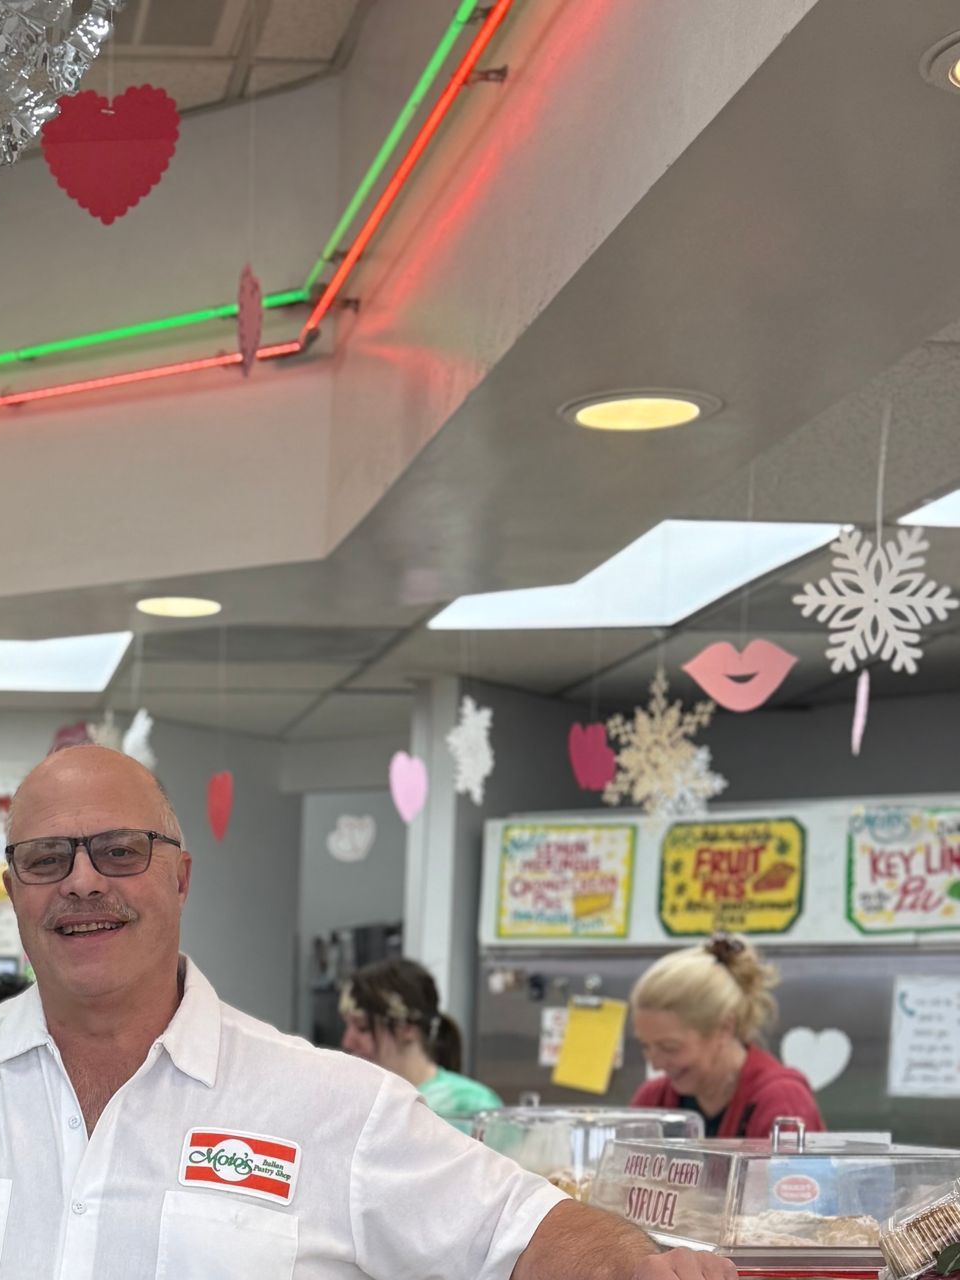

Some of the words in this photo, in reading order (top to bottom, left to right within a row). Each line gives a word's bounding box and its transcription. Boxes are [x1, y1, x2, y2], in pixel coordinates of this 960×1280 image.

[693, 845, 766, 880] FRUIT
[869, 846, 915, 884] KEY
[188, 1147, 254, 1176] Moio's
[253, 1164, 275, 1177] Pastry
[275, 1169, 292, 1181] Shop
[262, 1159, 284, 1171] Italian
[624, 1154, 649, 1178] APPLE
[668, 1160, 702, 1186] CHERRY
[625, 1186, 678, 1227] STRUDEL
